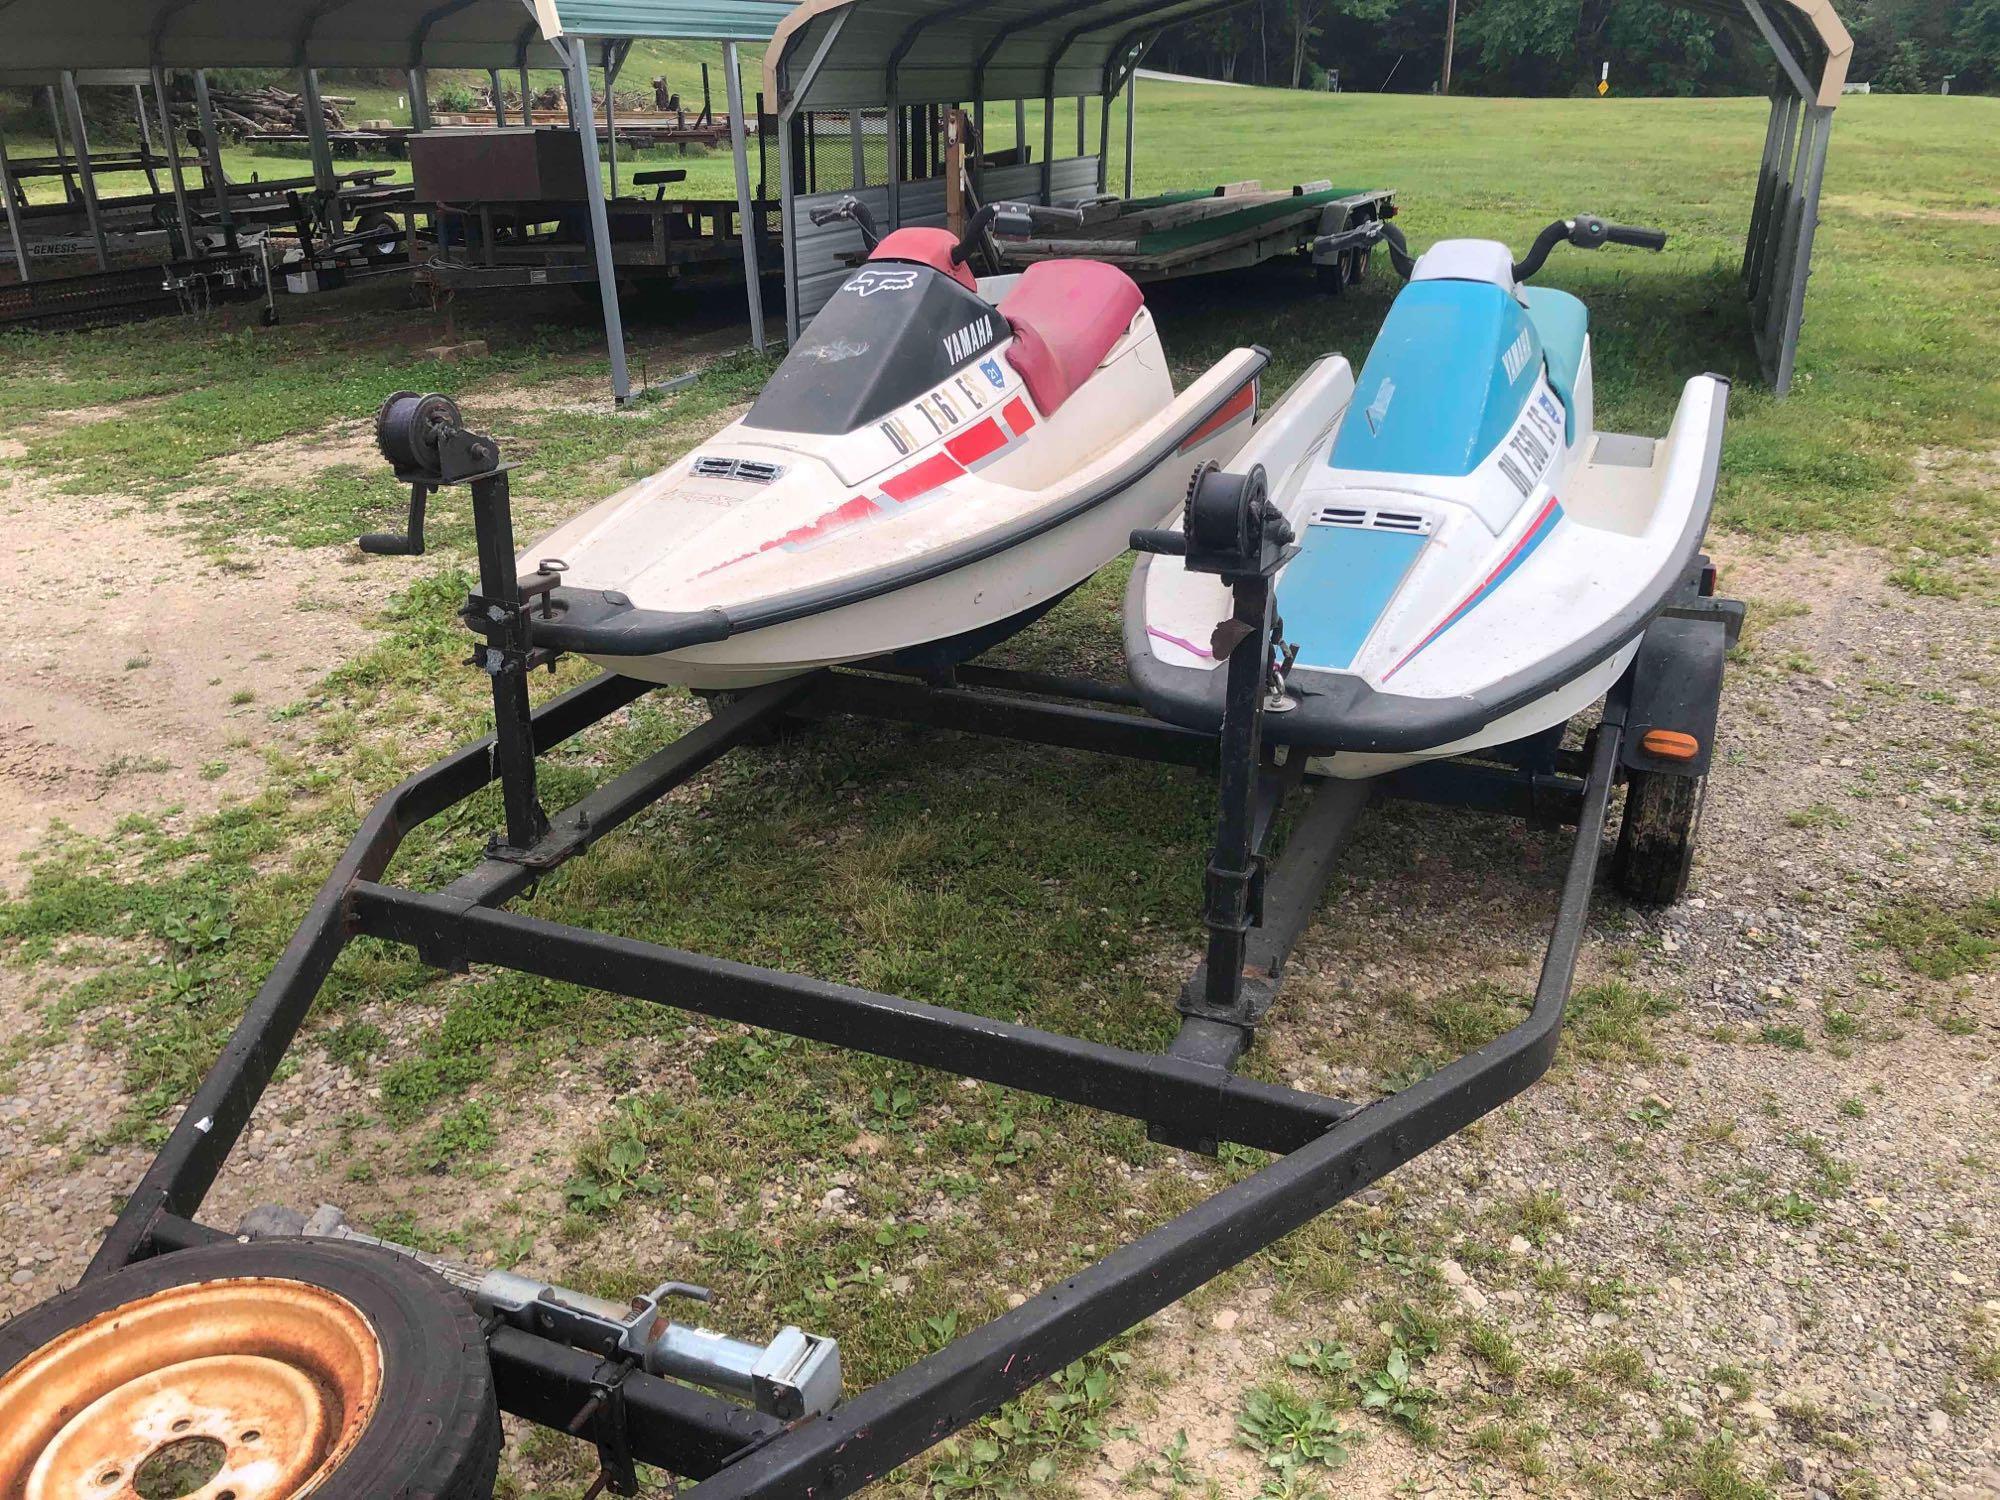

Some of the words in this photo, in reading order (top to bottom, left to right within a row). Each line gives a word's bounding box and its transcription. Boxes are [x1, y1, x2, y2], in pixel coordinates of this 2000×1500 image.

[33, 243, 78, 255] GENESIS
[942, 313, 993, 366] YAMAHA
[914, 388, 967, 435] 7561
[955, 373, 988, 410] ES
[1509, 423, 1549, 478] 7560
